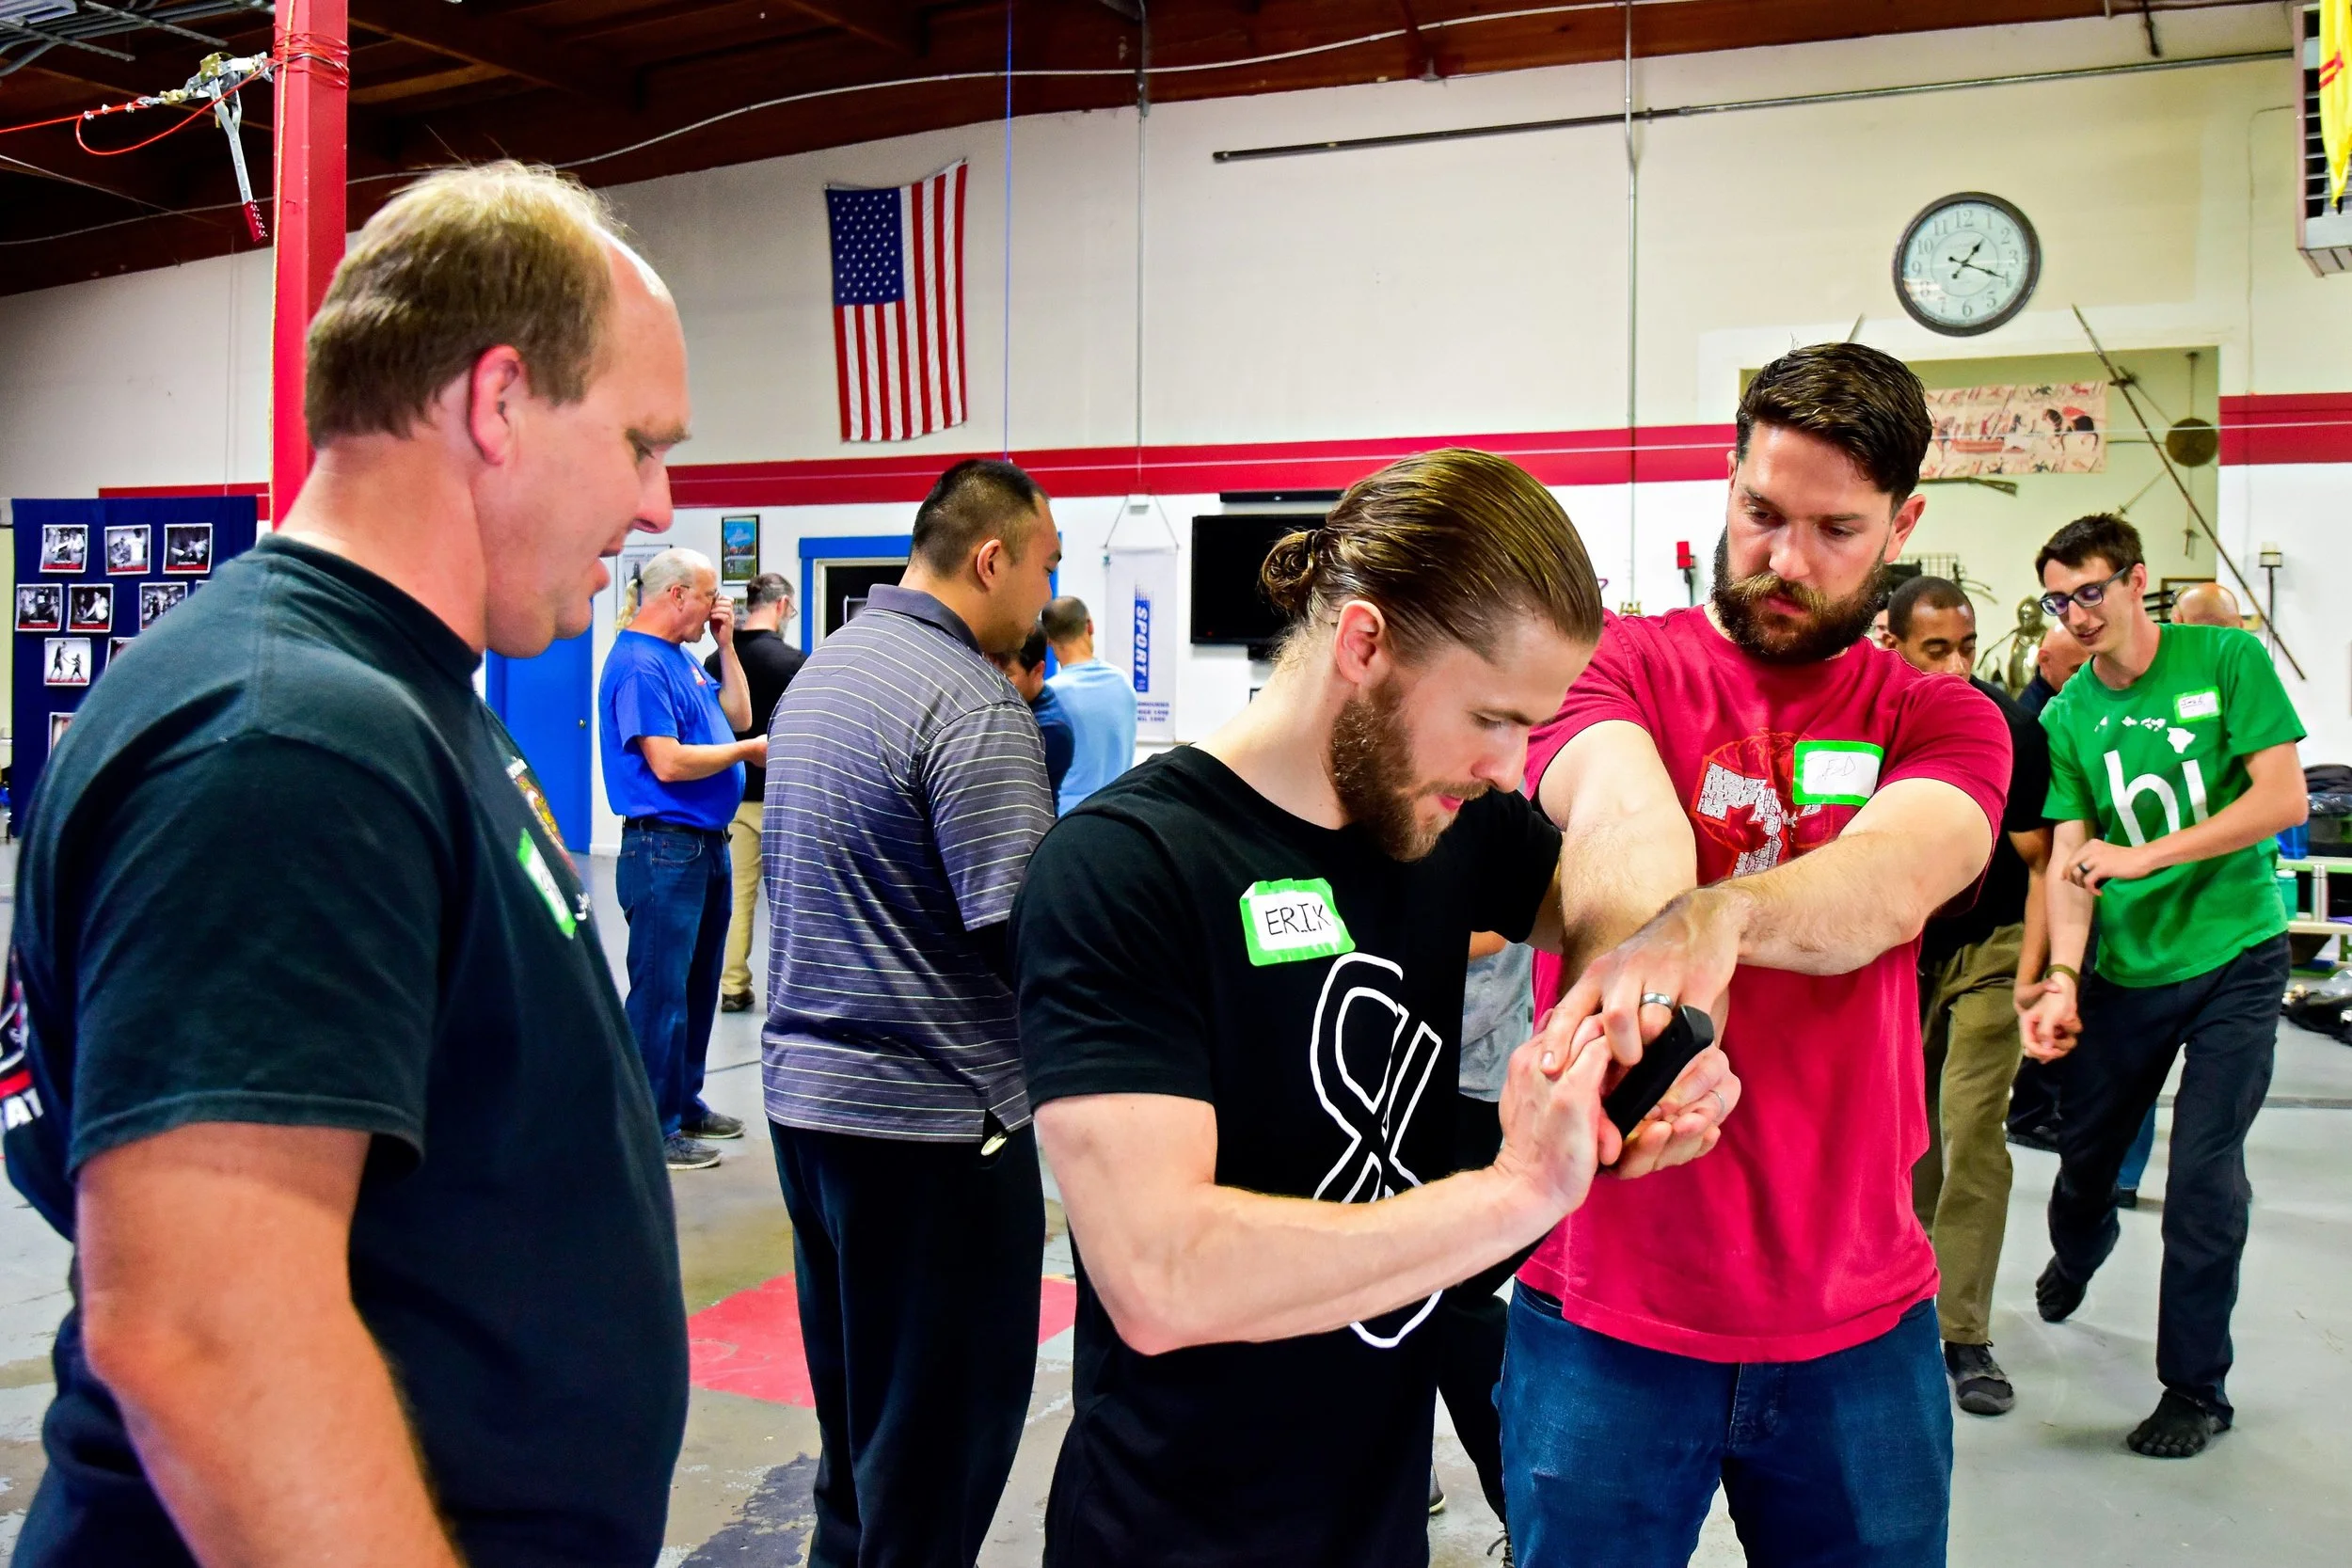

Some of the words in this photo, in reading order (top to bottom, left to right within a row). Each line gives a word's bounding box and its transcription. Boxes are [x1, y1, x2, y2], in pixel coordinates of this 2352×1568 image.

[1933, 219, 1948, 235] 11
[1955, 209, 1974, 229] 12
[1986, 213, 1994, 230] 1
[2001, 228, 2010, 245] 2
[1917, 239, 1933, 256] 10
[2009, 249, 2019, 265] 3
[1912, 261, 1922, 275] 9
[1937, 296, 1947, 313] 7
[1962, 300, 1973, 317] 6
[1986, 291, 1996, 309] 5
[1135, 605, 1148, 677] SPORT
[2104, 749, 2209, 847] hi
[1265, 903, 1332, 936] ERIK
